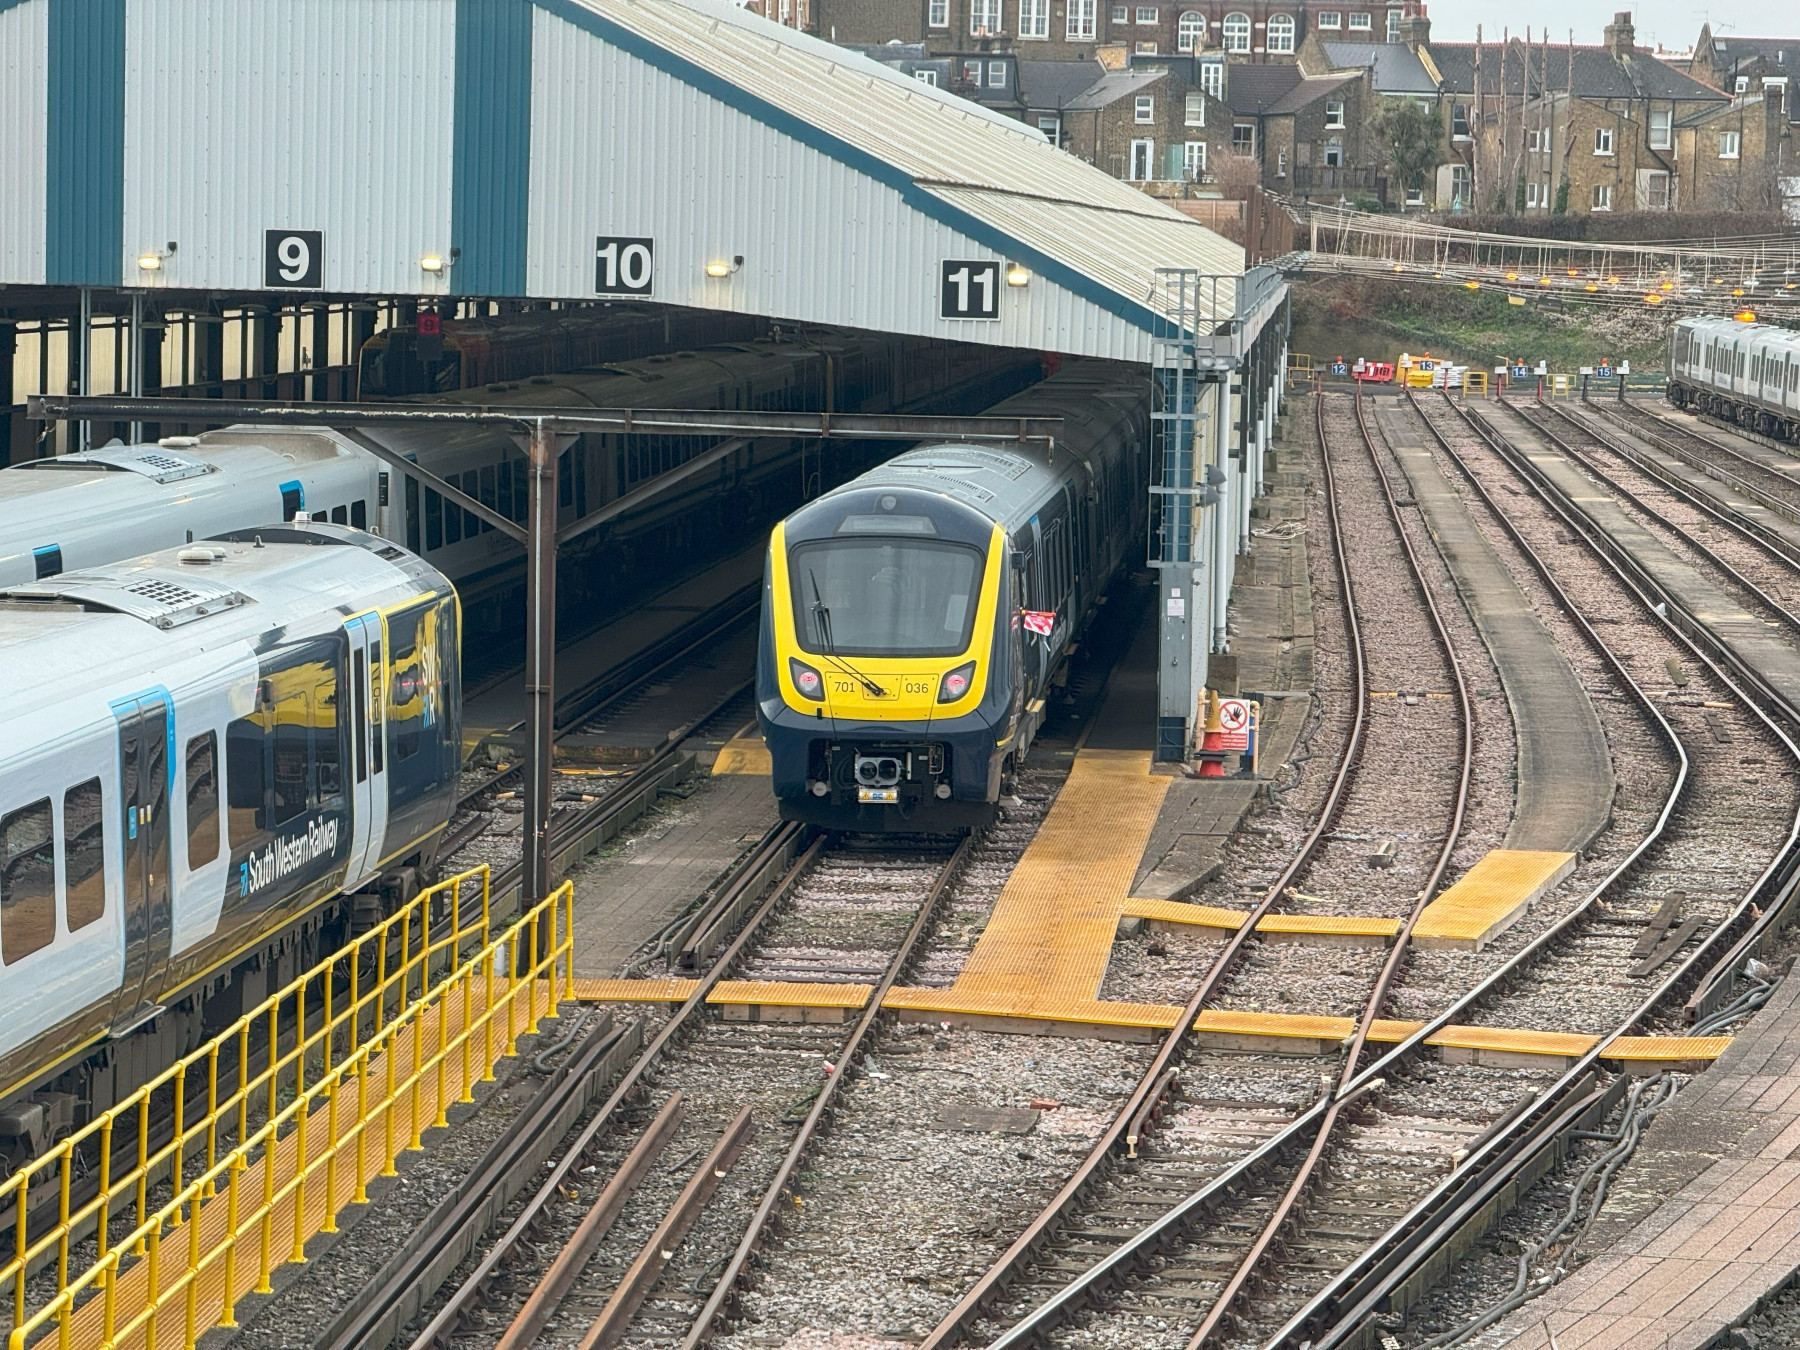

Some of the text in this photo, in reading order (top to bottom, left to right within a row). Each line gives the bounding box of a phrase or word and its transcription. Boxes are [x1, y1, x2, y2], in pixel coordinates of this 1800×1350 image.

[278, 236, 309, 281] 9
[597, 242, 651, 288] 10
[948, 267, 993, 312] 11
[1333, 364, 1346, 374] 12
[1420, 361, 1433, 370] 13
[1513, 367, 1526, 376] 14
[1598, 368, 1611, 376] 15
[422, 643, 436, 686] SW
[429, 686, 436, 726] R
[834, 681, 929, 694] 701 036
[249, 814, 338, 894] South Western Railway
